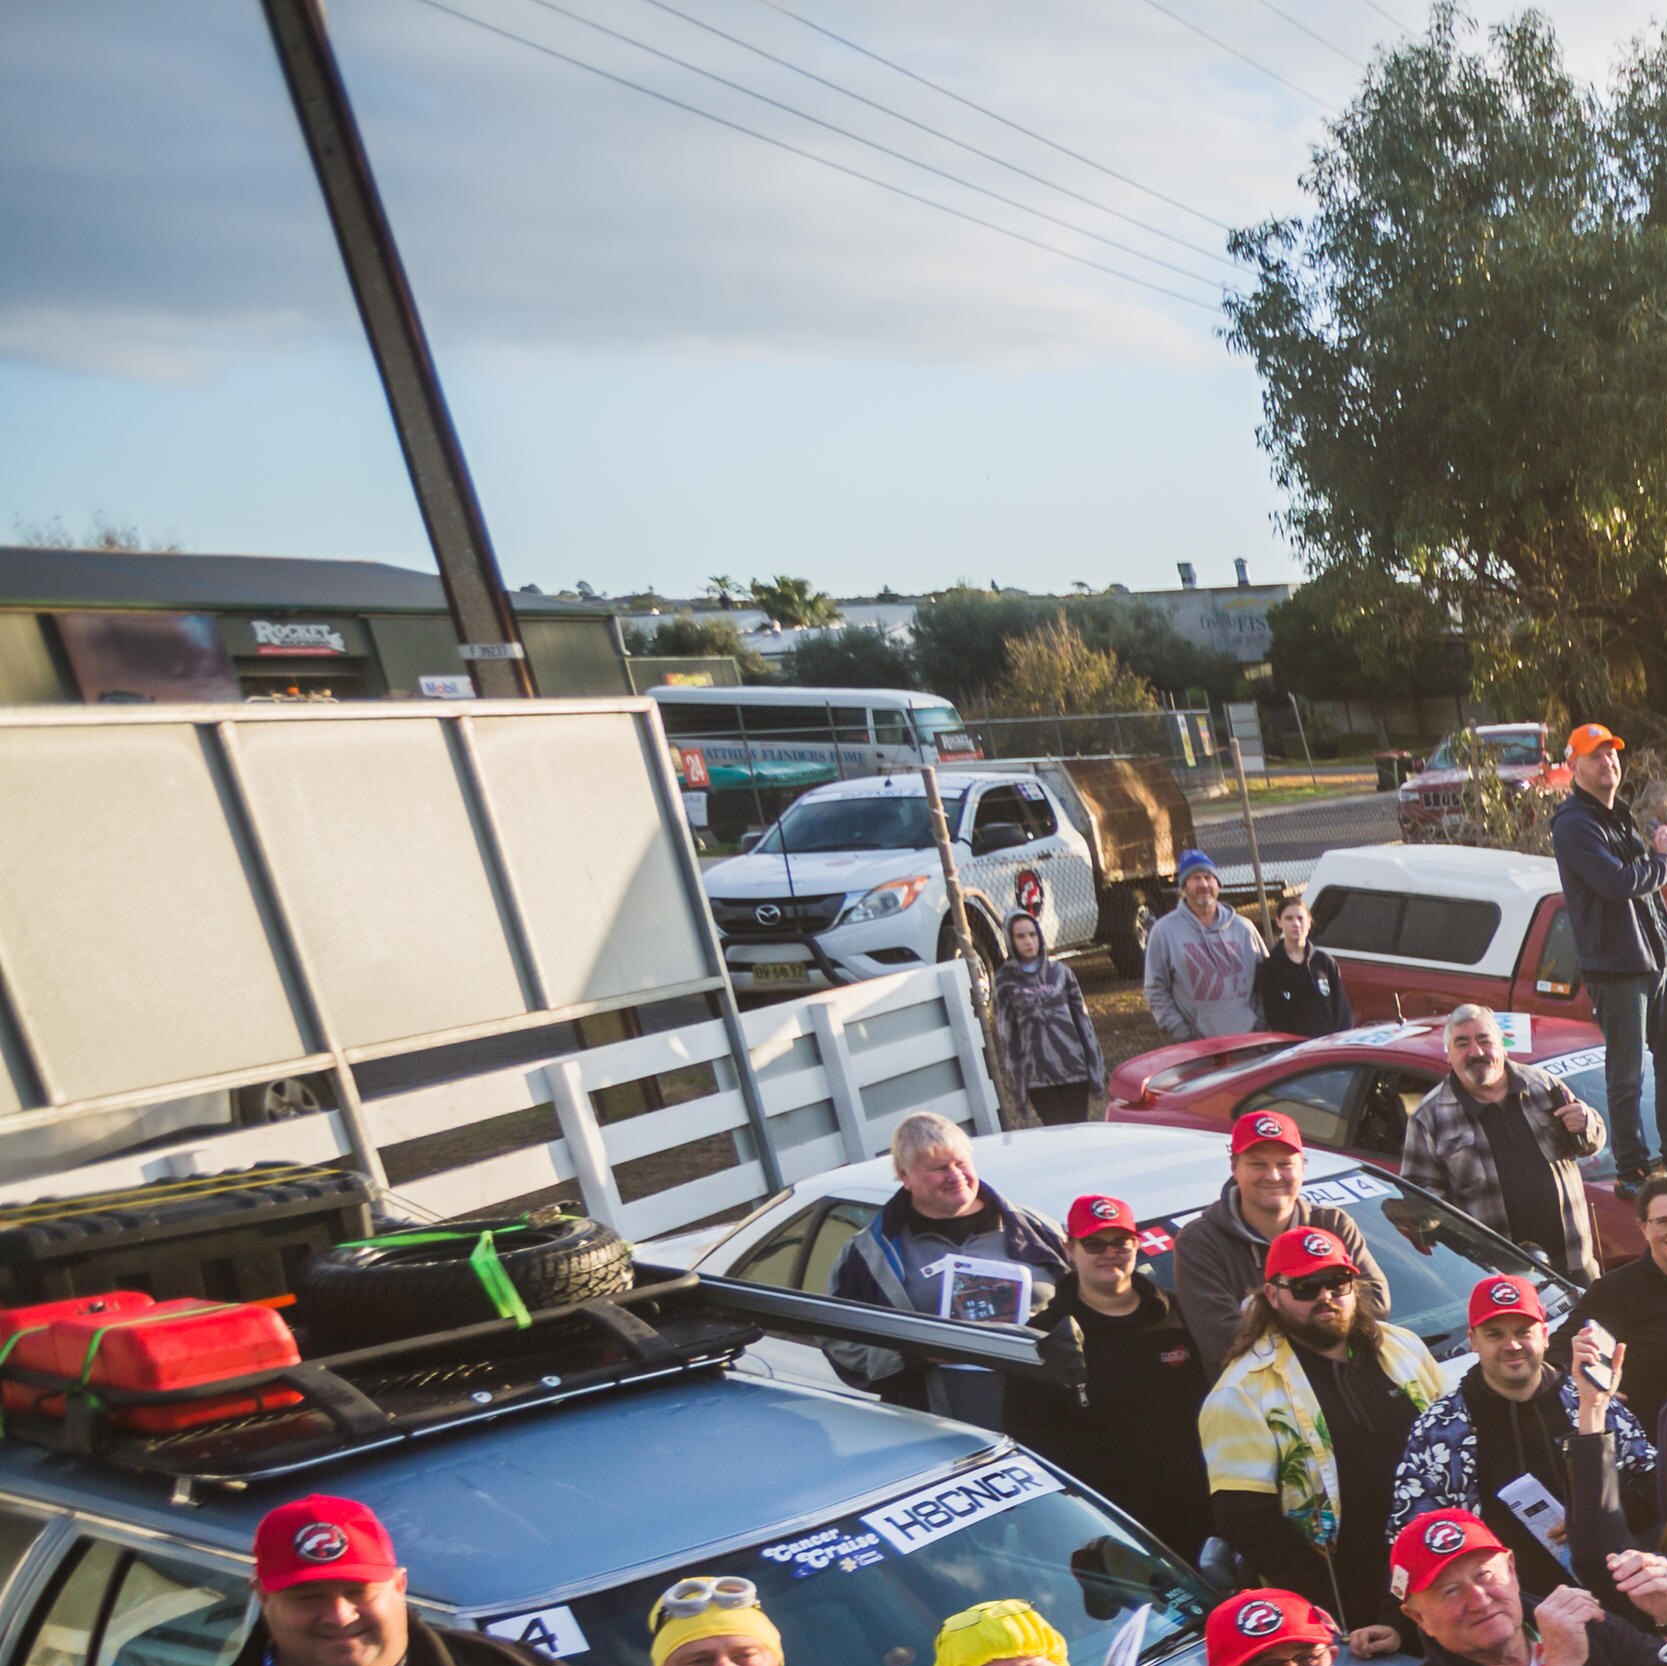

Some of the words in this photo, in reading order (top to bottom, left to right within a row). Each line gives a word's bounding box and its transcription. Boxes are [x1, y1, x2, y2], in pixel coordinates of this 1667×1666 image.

[425, 681, 459, 694] Mobil
[687, 754, 707, 784] 24
[704, 748, 759, 765] ATTHEW
[761, 750, 827, 764] FLINDERS
[890, 1470, 1043, 1539] H8CNCR
[762, 1527, 841, 1563] Cancer
[795, 1532, 882, 1570] Cruise
